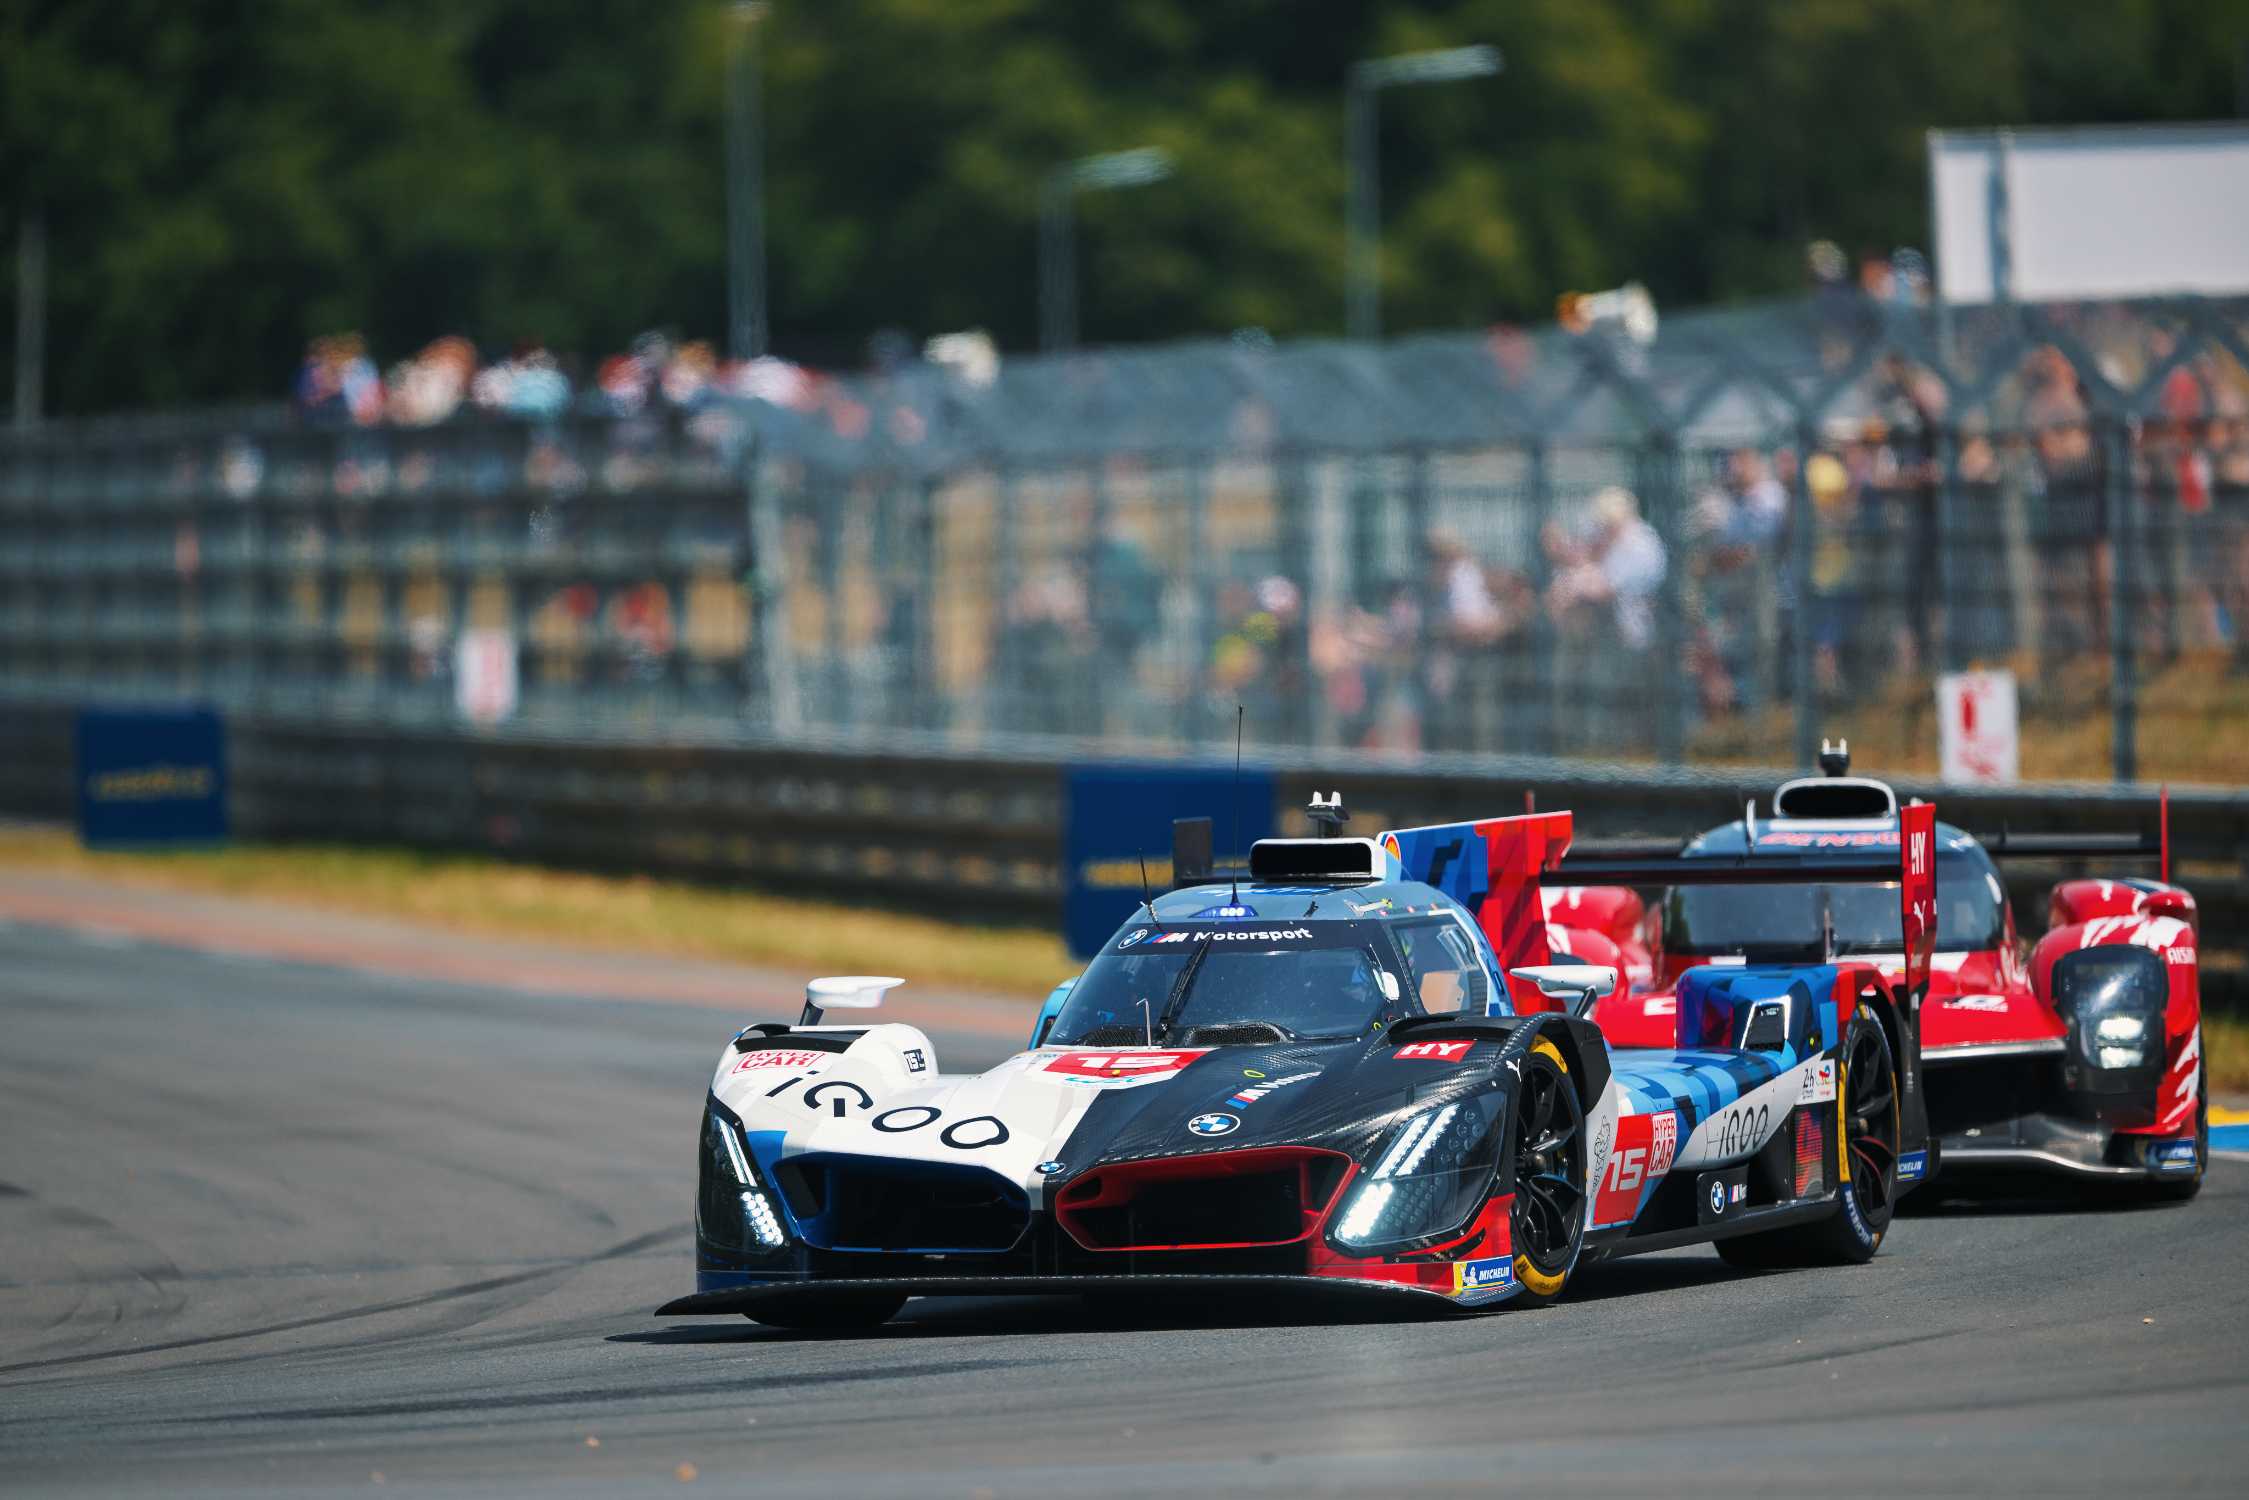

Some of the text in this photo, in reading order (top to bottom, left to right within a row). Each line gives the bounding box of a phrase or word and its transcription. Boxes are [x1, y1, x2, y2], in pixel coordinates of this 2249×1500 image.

[1911, 831, 1926, 875] HY
[1193, 927, 1313, 942] Motorsport
[1400, 1043, 1472, 1056] HY
[741, 1056, 811, 1069] CAR
[1078, 1055, 1181, 1069] 15
[1654, 1117, 1676, 1139] HYPER
[1650, 1138, 1675, 1172] CAR
[1602, 1148, 1647, 1192] 15
[1478, 1266, 1510, 1281] MICHELIN
